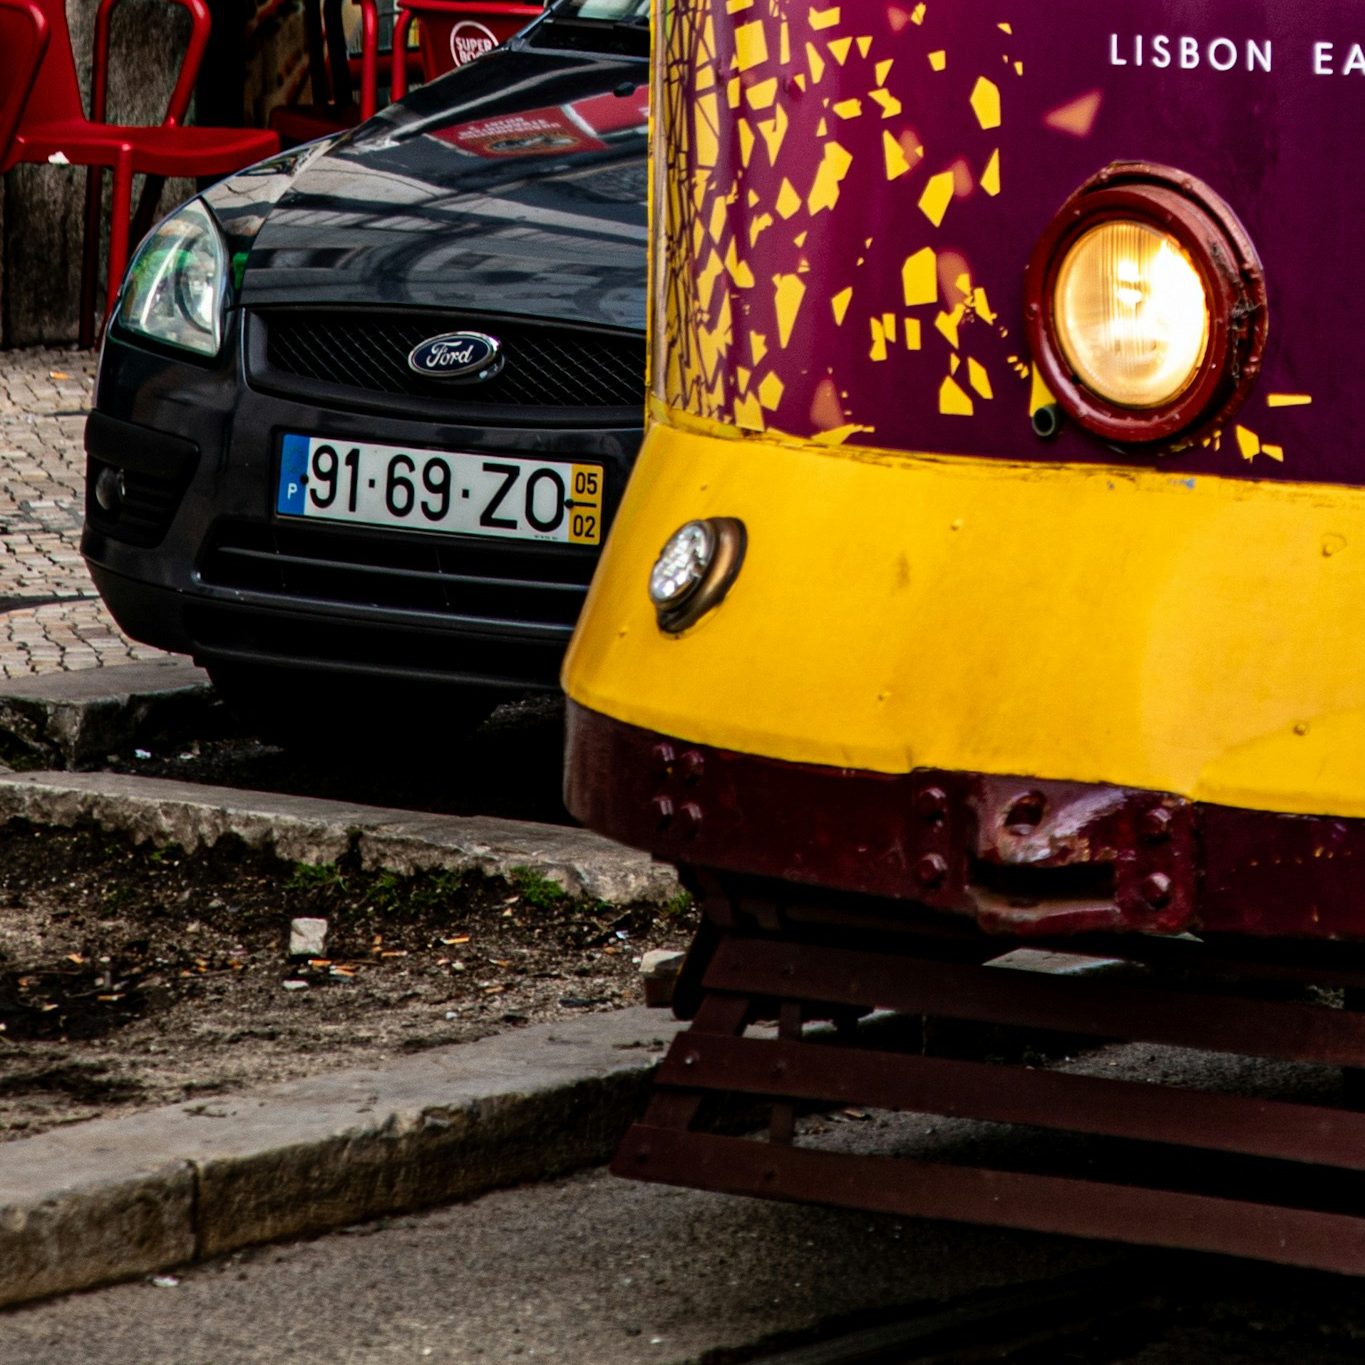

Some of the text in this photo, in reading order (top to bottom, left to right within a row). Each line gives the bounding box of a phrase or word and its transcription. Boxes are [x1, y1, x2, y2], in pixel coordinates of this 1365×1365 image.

[455, 36, 493, 53] SUPER
[1108, 33, 1273, 73] LISBON
[426, 340, 475, 368] Ford
[286, 482, 298, 500] P
[575, 471, 598, 495] 05
[573, 514, 596, 538] 02
